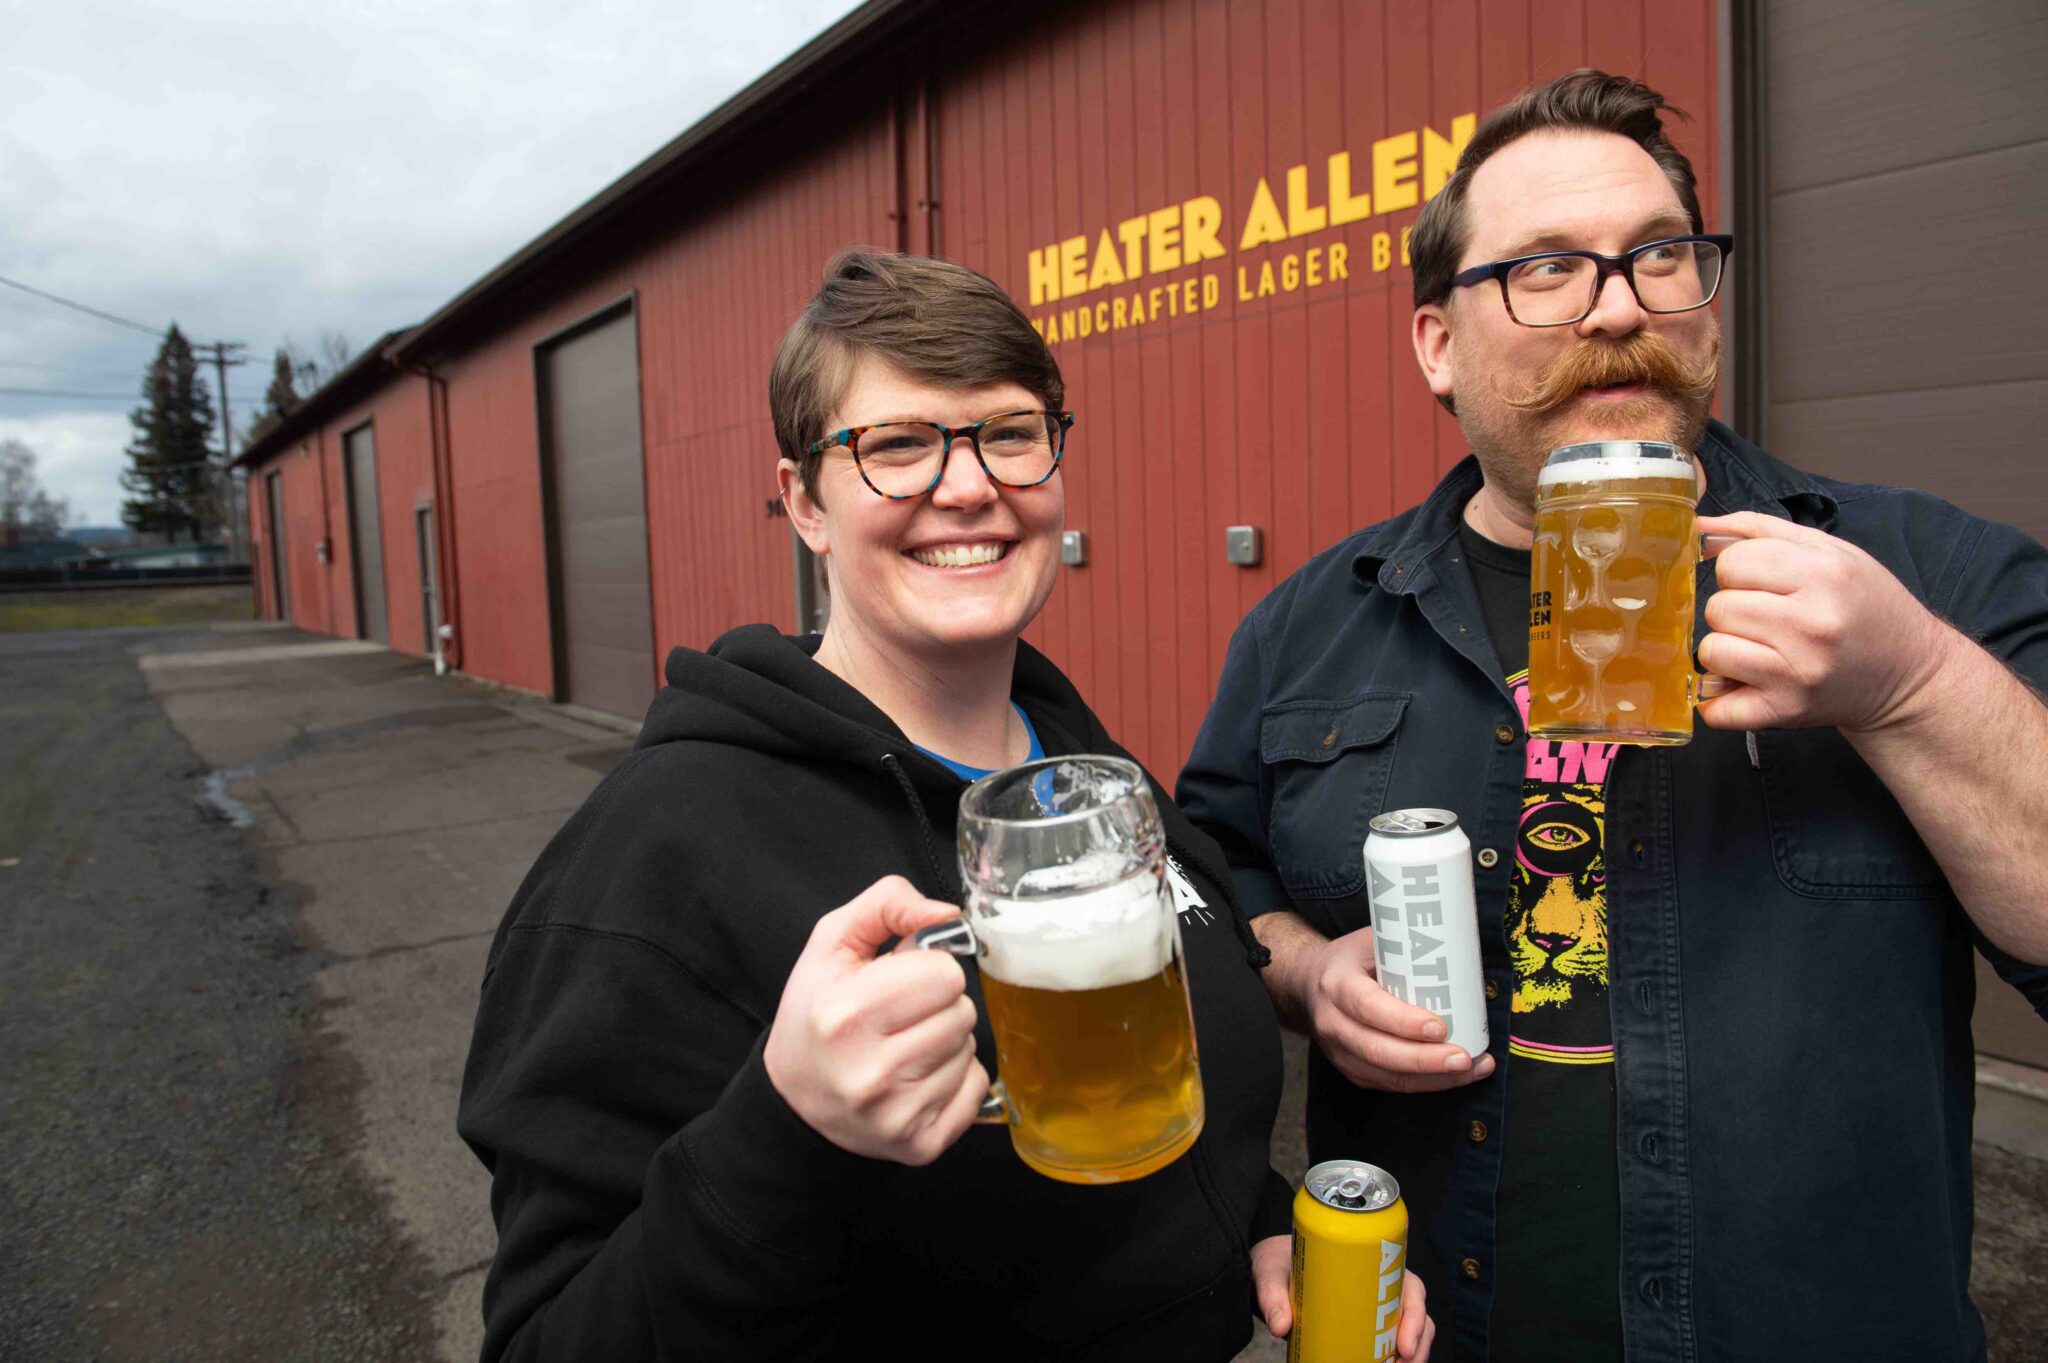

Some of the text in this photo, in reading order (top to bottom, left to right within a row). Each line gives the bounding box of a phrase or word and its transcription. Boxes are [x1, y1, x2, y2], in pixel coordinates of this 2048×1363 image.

[1029, 112, 1477, 306] HEATER ALLEN
[1238, 242, 1348, 301] LAGER
